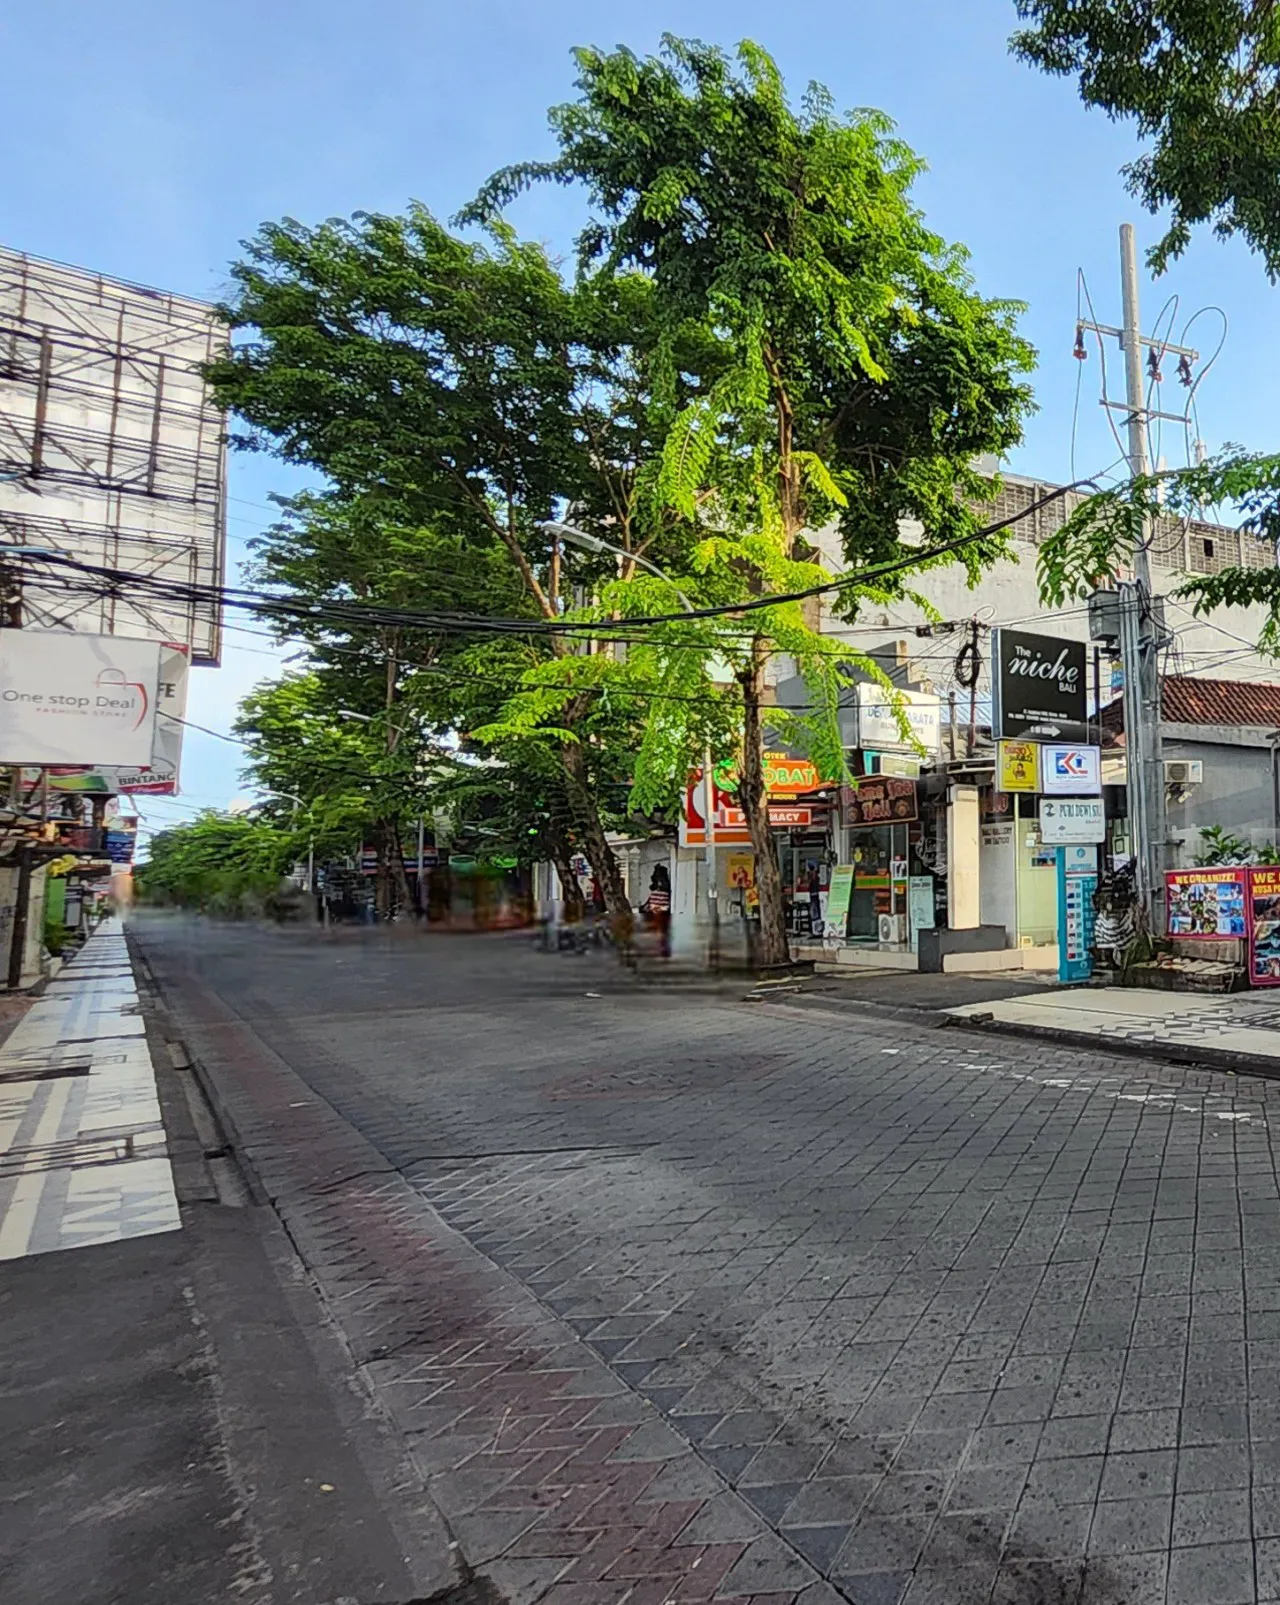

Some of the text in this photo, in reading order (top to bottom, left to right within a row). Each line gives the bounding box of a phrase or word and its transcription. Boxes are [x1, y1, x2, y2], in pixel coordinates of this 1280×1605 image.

[1015, 645, 1031, 657] The
[1008, 648, 1079, 682] niche
[1059, 682, 1076, 693] BALI
[2, 689, 135, 709] One stop Deal
[118, 771, 175, 786] BINTANG
[738, 812, 800, 822] PMACY
[1059, 804, 1074, 818] PURI
[1253, 872, 1276, 884] WE
